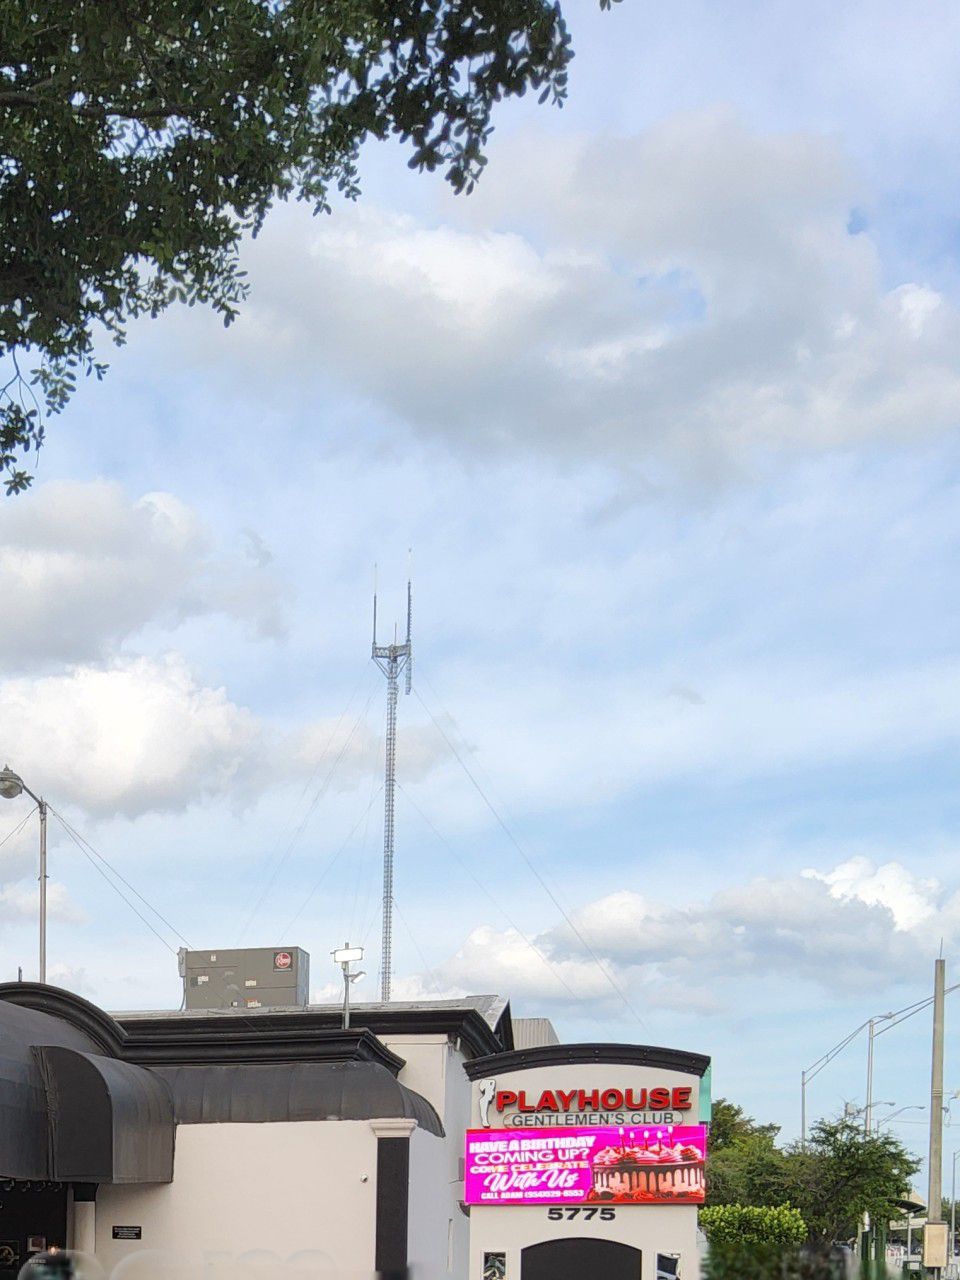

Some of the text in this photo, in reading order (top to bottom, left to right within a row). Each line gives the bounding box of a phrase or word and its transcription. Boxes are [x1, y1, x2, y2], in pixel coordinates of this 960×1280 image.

[495, 1087, 693, 1112] PLAYHOUSE
[511, 1112, 674, 1127] GENTLEMEN'S CLUB
[469, 1136, 596, 1153] HAVE A BIRTHDAY
[474, 1148, 590, 1164] COMING UP?
[470, 1161, 590, 1174] COME CELEBRATE
[483, 1169, 579, 1192] With Us
[480, 1192, 499, 1200] CALL
[547, 1207, 616, 1221] 5775
